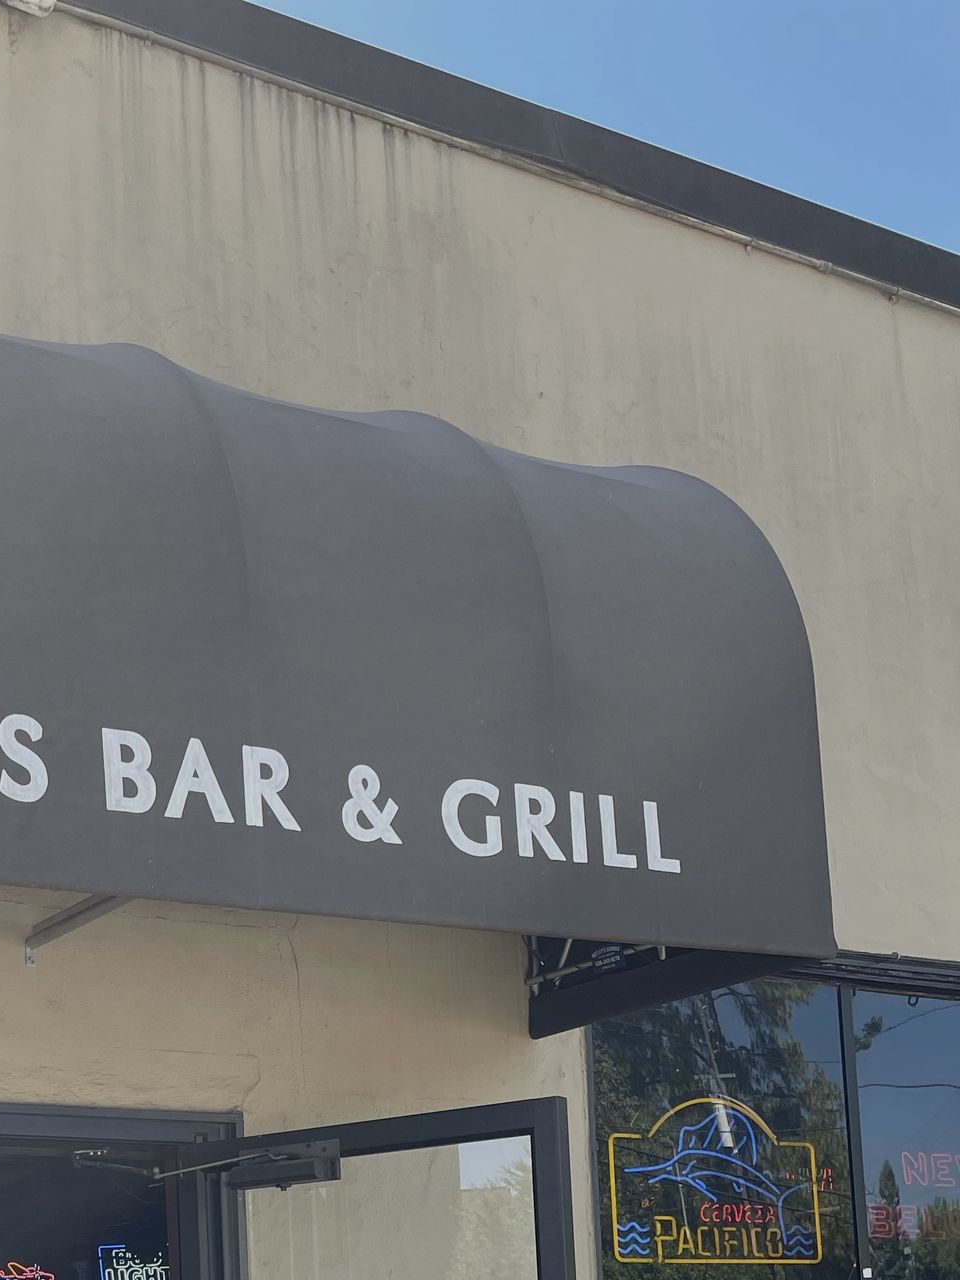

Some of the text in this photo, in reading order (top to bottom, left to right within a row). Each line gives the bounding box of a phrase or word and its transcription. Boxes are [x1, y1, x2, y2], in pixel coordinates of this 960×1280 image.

[102, 727, 302, 832] BAR
[342, 764, 402, 845] &
[441, 778, 681, 874] GRILL
[901, 1151, 960, 1187] NE
[654, 1216, 783, 1263] PACIFICO
